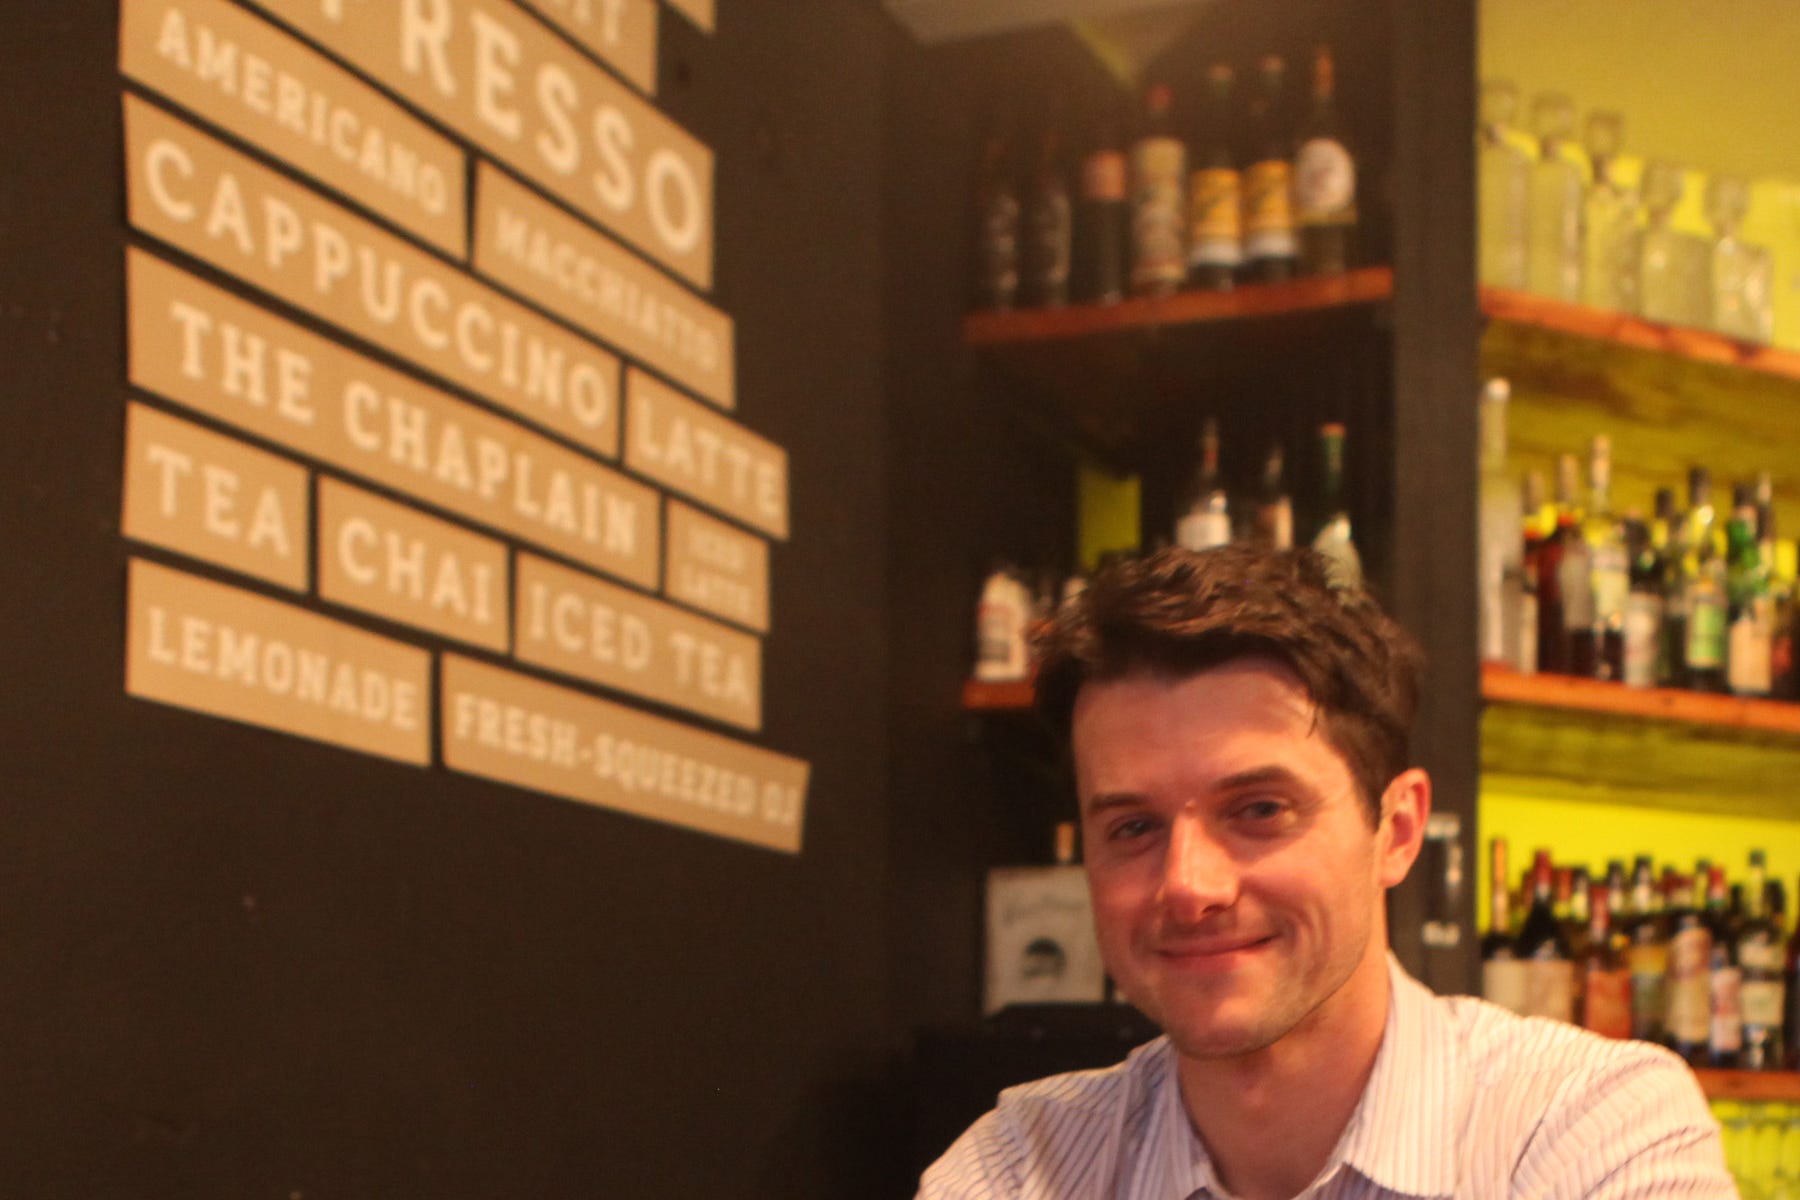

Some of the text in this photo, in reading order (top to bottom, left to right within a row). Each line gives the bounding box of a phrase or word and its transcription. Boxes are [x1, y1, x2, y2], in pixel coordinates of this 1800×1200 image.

[156, 9, 448, 216] AMERICANO
[320, 0, 701, 254] RESSO
[145, 139, 609, 429] CAPPUCCINO
[170, 300, 637, 557] THE CHAPLAIN
[636, 394, 785, 519] LATTE
[147, 442, 290, 557] TEA
[337, 517, 494, 627] CHAI
[147, 606, 420, 731] LEMONADE
[529, 582, 754, 707] ICED TEA
[453, 691, 757, 818] FRESH-SQUEEZED
